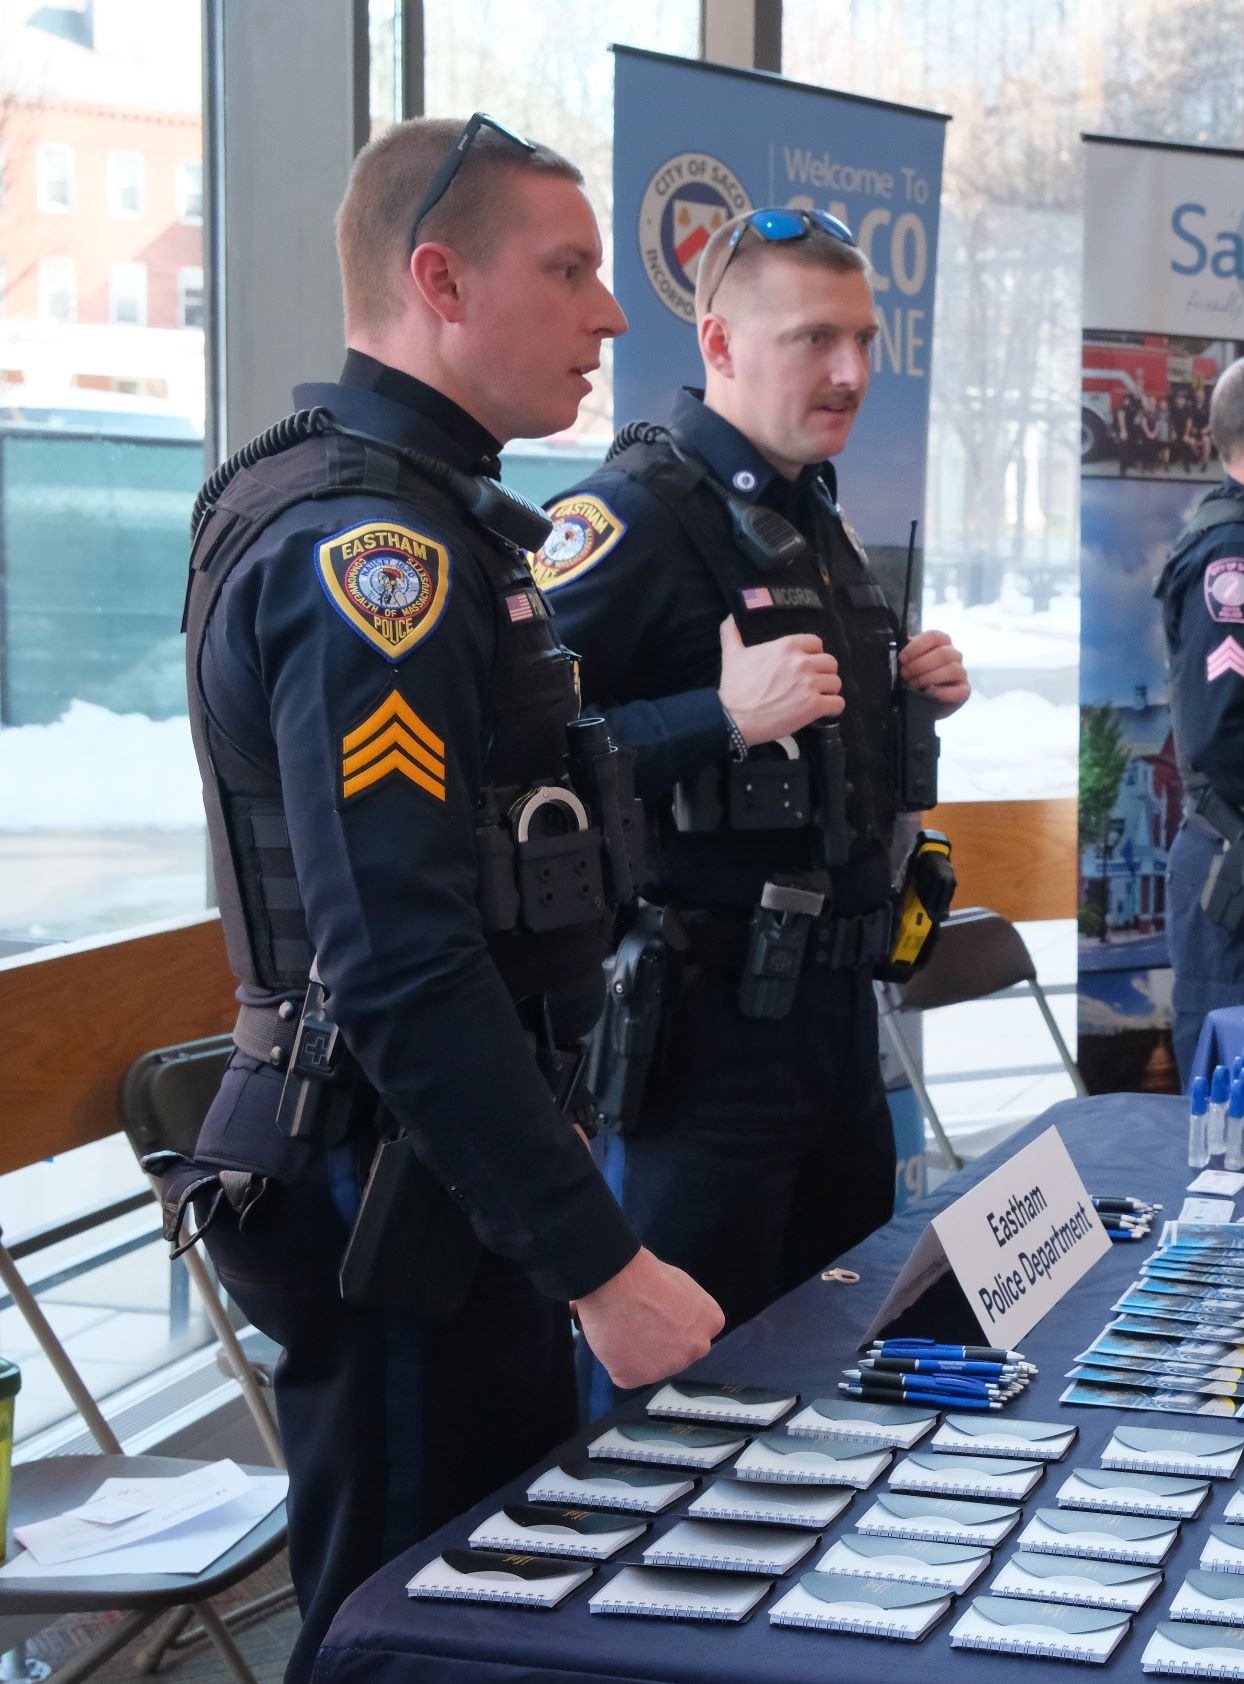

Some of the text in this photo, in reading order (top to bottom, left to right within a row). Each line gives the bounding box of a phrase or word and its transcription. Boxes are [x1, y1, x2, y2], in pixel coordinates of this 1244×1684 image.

[654, 158, 746, 210] CITY OF SACO
[783, 146, 928, 205] Welcome To
[784, 195, 927, 296] CO
[646, 249, 696, 316] INCORPO
[341, 531, 427, 561] EASTHAM
[555, 502, 609, 535] EASTHAM
[347, 557, 430, 617] COMMONWEALTH OF MASSACHUSETTS
[397, 561, 416, 578] 1620
[373, 616, 414, 645] POLICE
[986, 1185, 1048, 1248] Eastham
[978, 1201, 1093, 1323] Police Department
